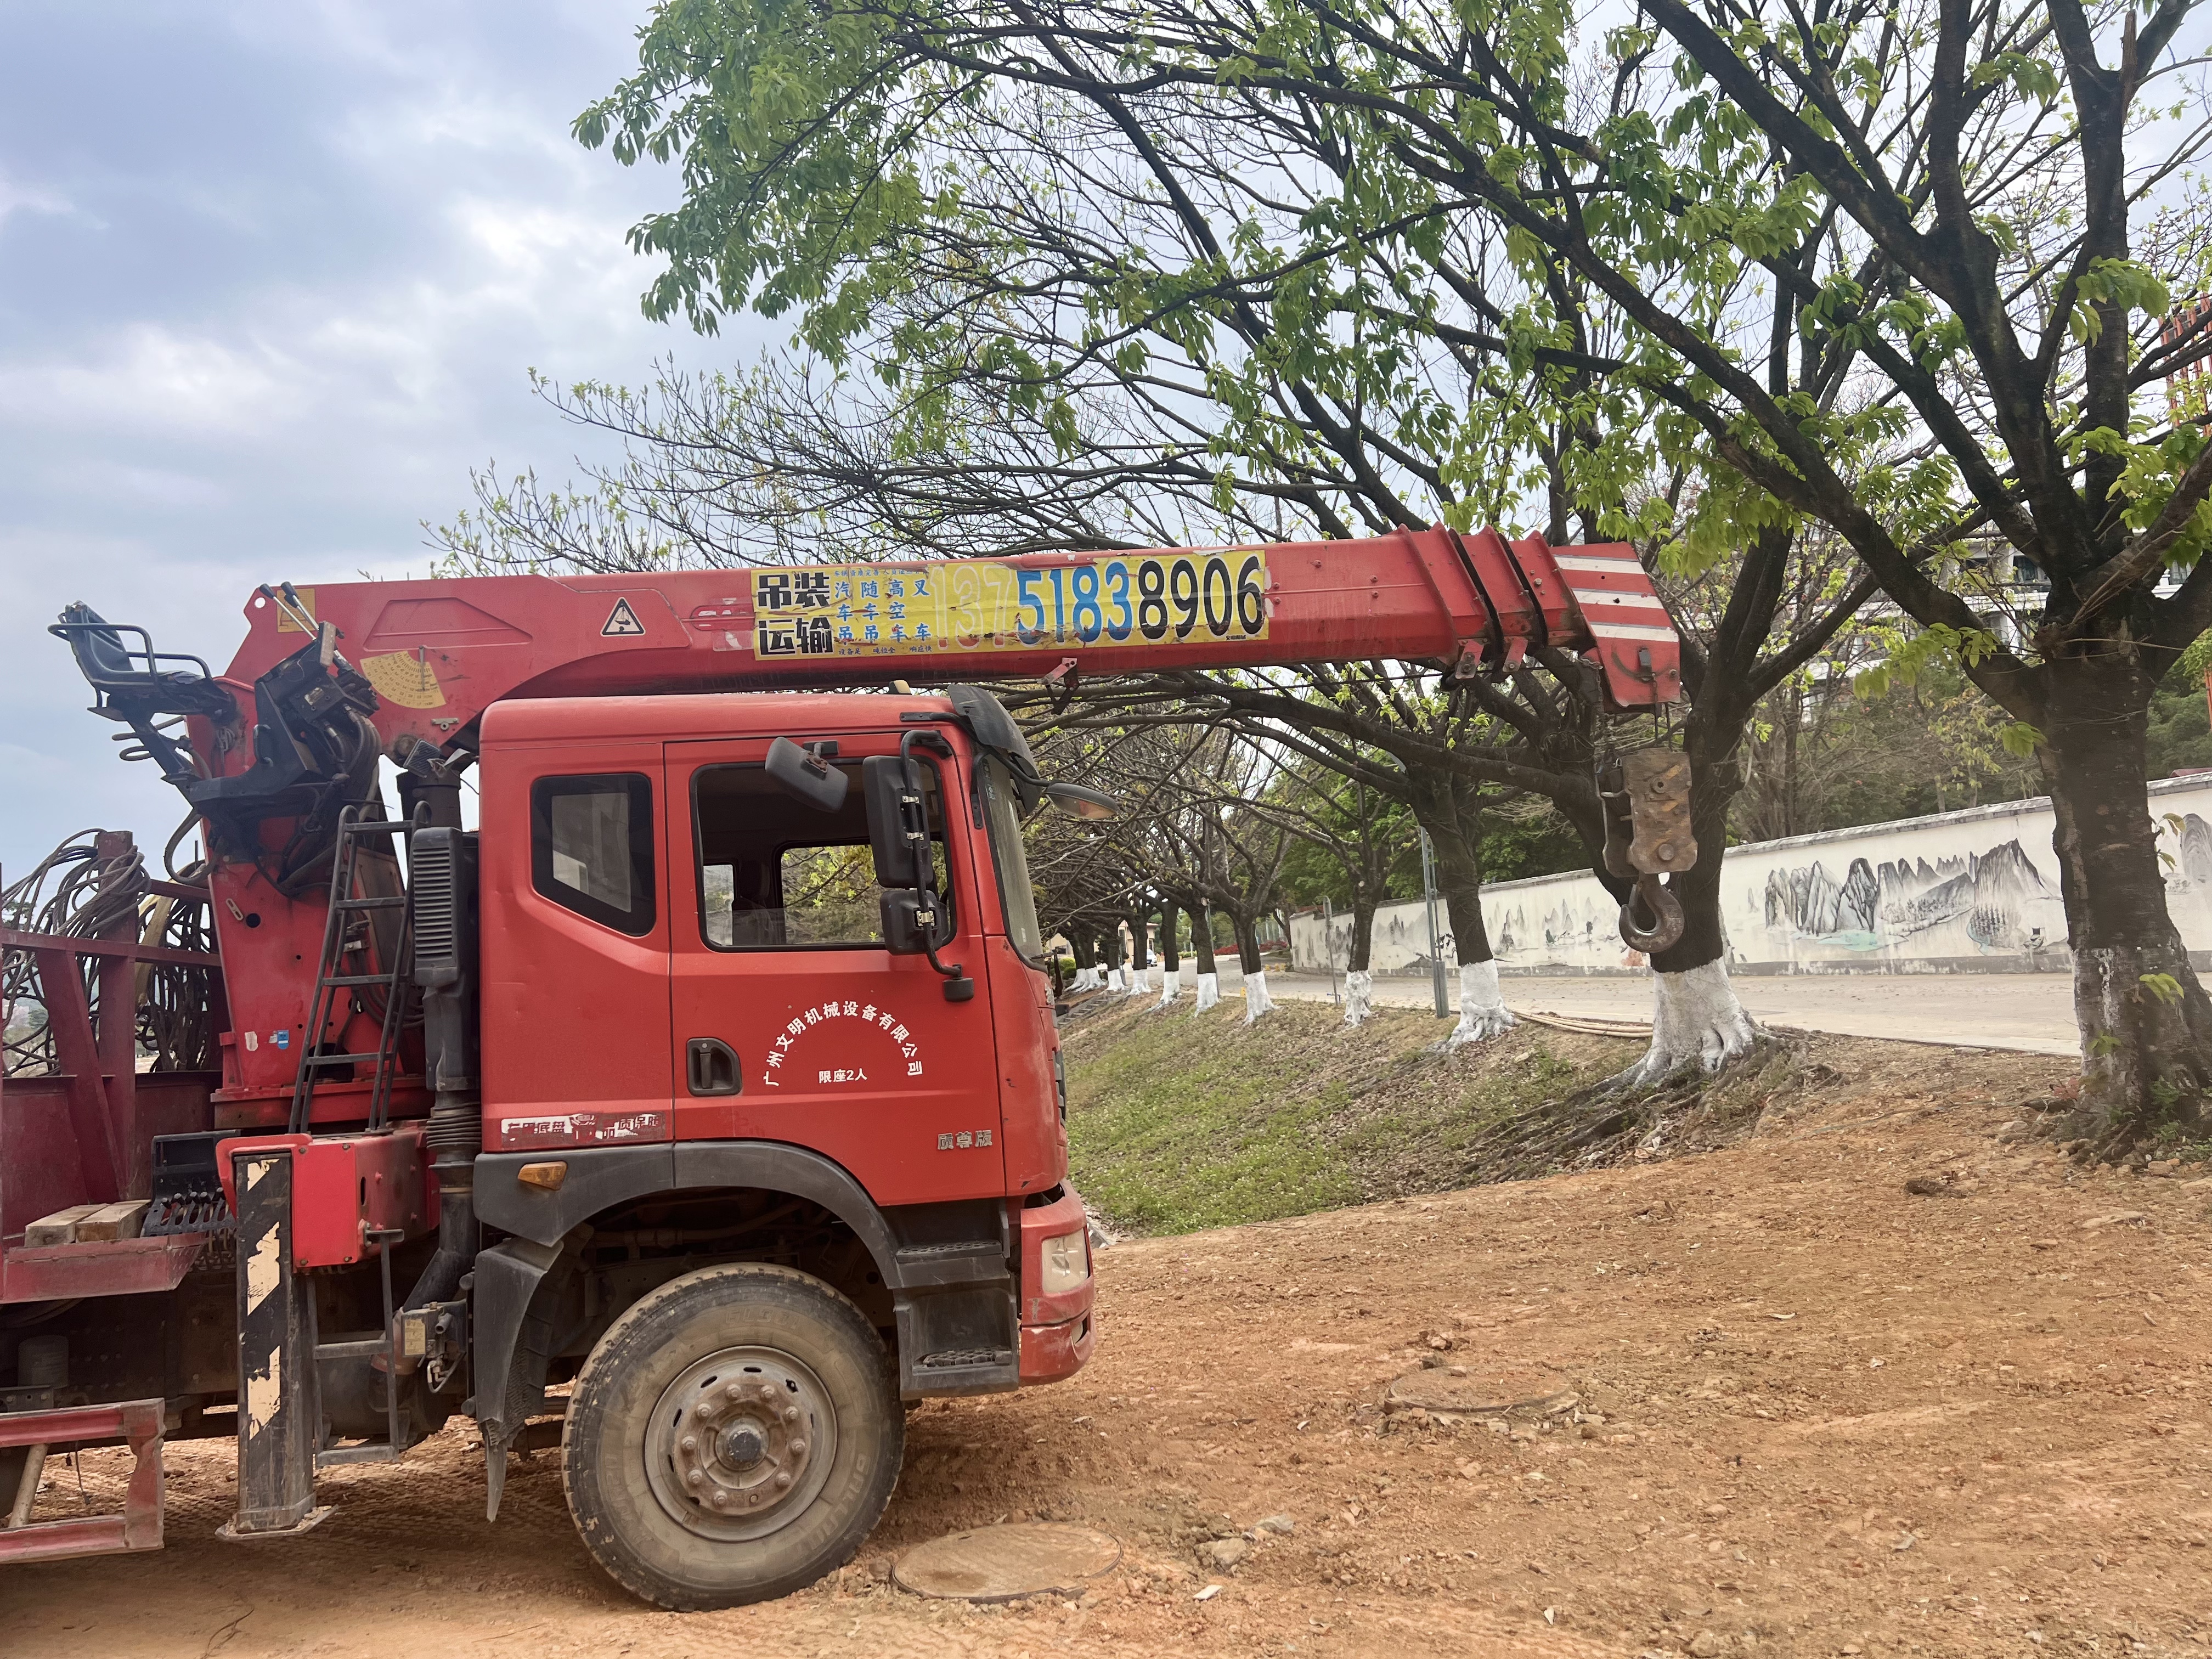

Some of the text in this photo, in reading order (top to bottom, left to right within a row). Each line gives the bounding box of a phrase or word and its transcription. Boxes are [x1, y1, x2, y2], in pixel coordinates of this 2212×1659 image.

[758, 572, 830, 610] 吊装
[912, 579, 932, 641] 叉车
[860, 580, 879, 644] 随车吊
[758, 616, 833, 656] 运输
[838, 645, 933, 656] 设备足 吨位全 响应快
[763, 1000, 923, 1087] 广州文明机械设备有限公司
[819, 1068, 868, 1084] 限座2人
